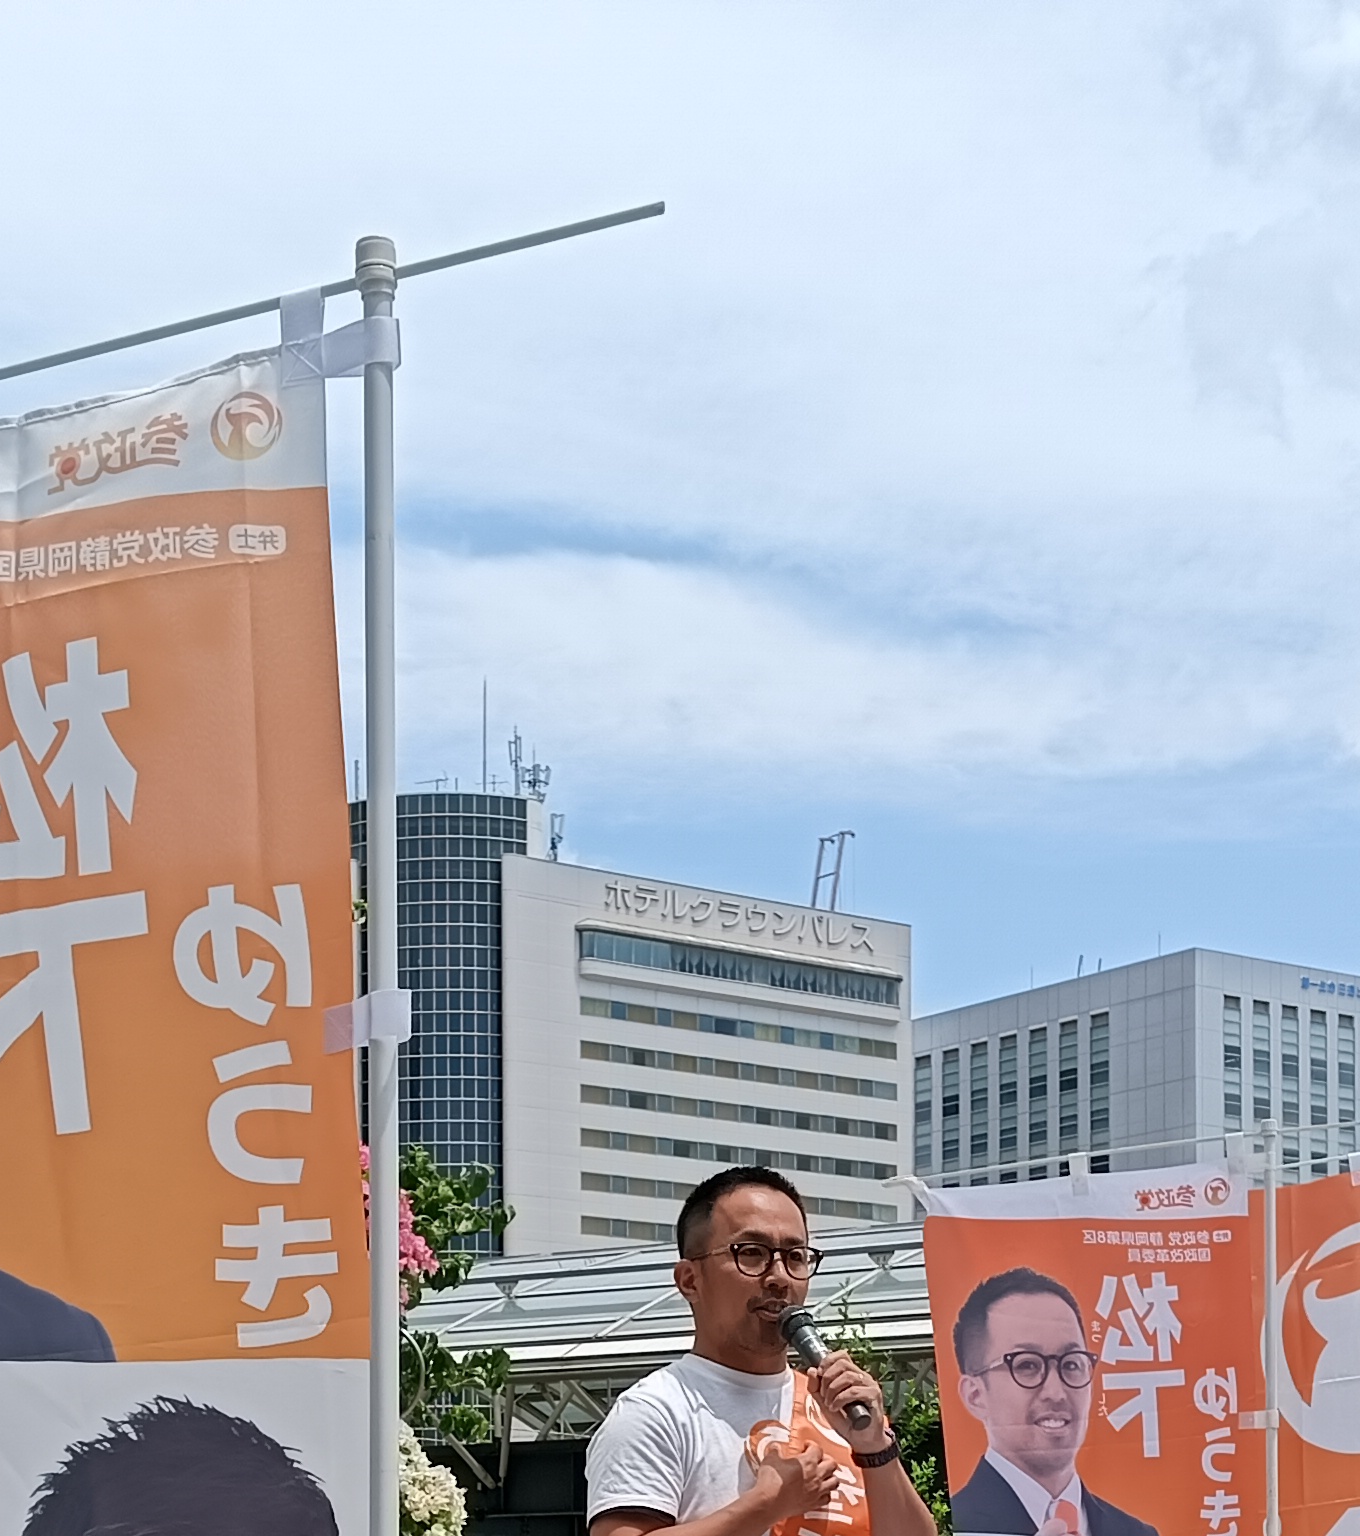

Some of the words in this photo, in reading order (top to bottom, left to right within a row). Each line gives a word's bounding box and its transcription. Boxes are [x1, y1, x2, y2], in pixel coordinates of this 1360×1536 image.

[604, 880, 875, 953] ホテルクラウンパレス
